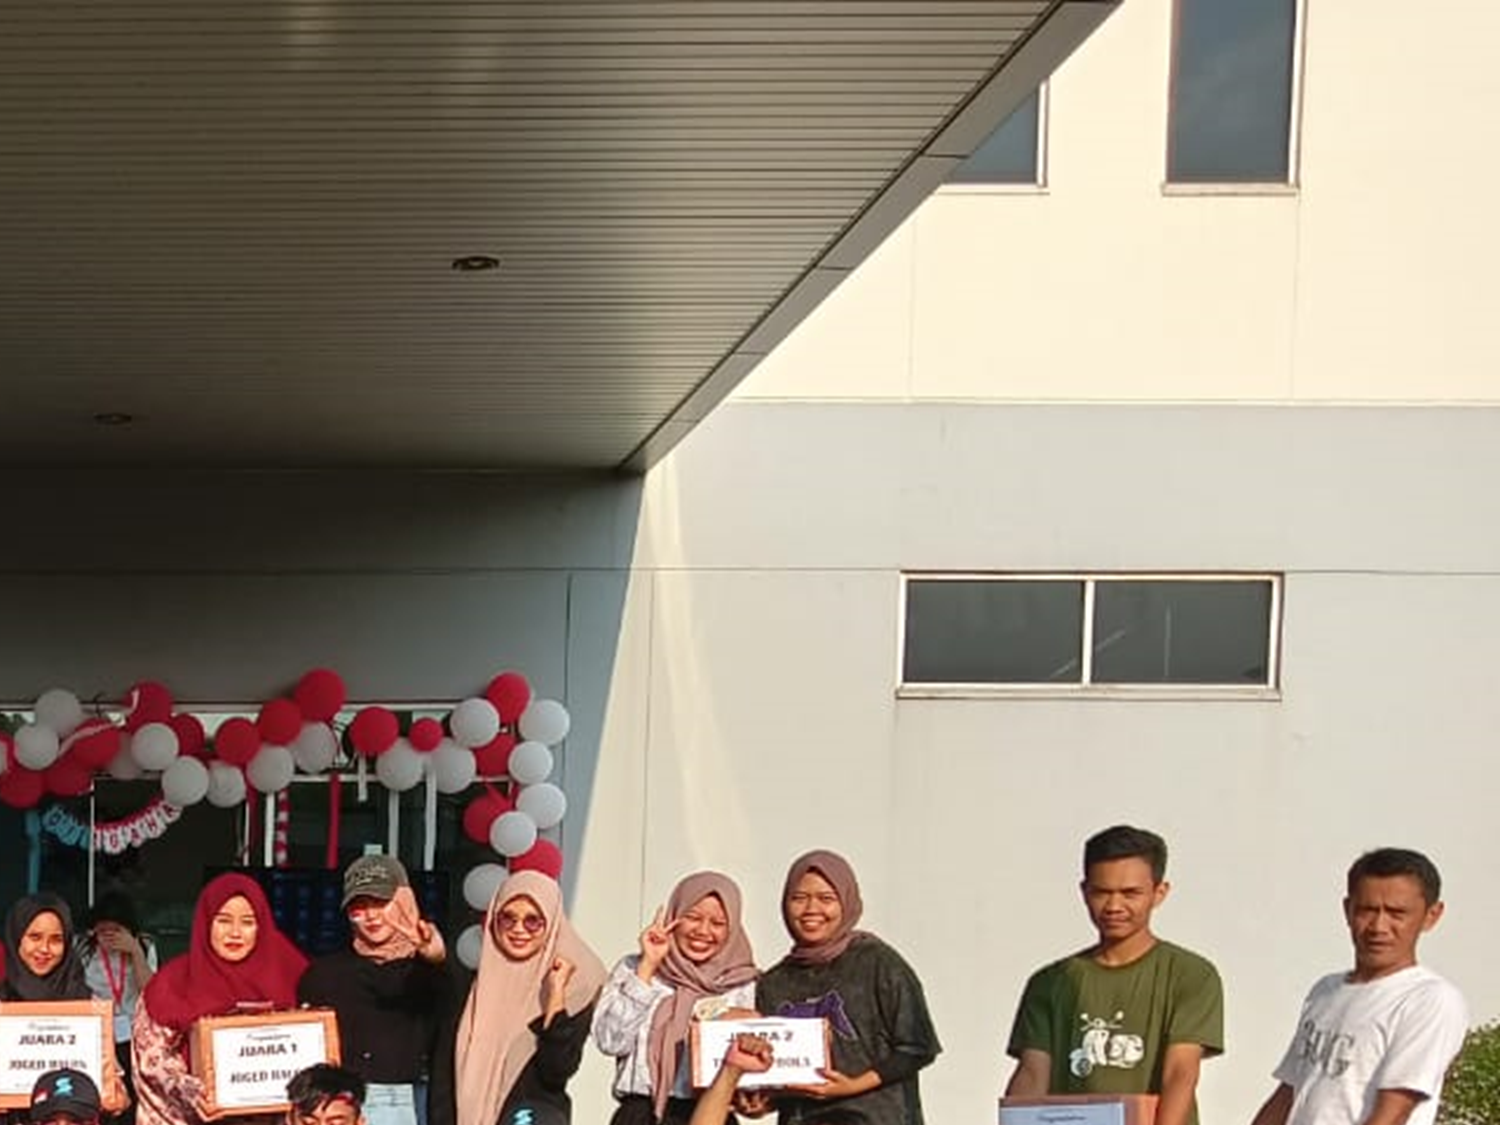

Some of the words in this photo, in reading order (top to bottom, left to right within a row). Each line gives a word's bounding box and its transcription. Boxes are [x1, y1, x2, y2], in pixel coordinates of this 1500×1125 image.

[19, 1034, 65, 1046] JUARA
[68, 1034, 76, 1045] 2
[783, 1031, 794, 1041] 2
[239, 1043, 287, 1057] JUARA
[291, 1043, 297, 1053] 1
